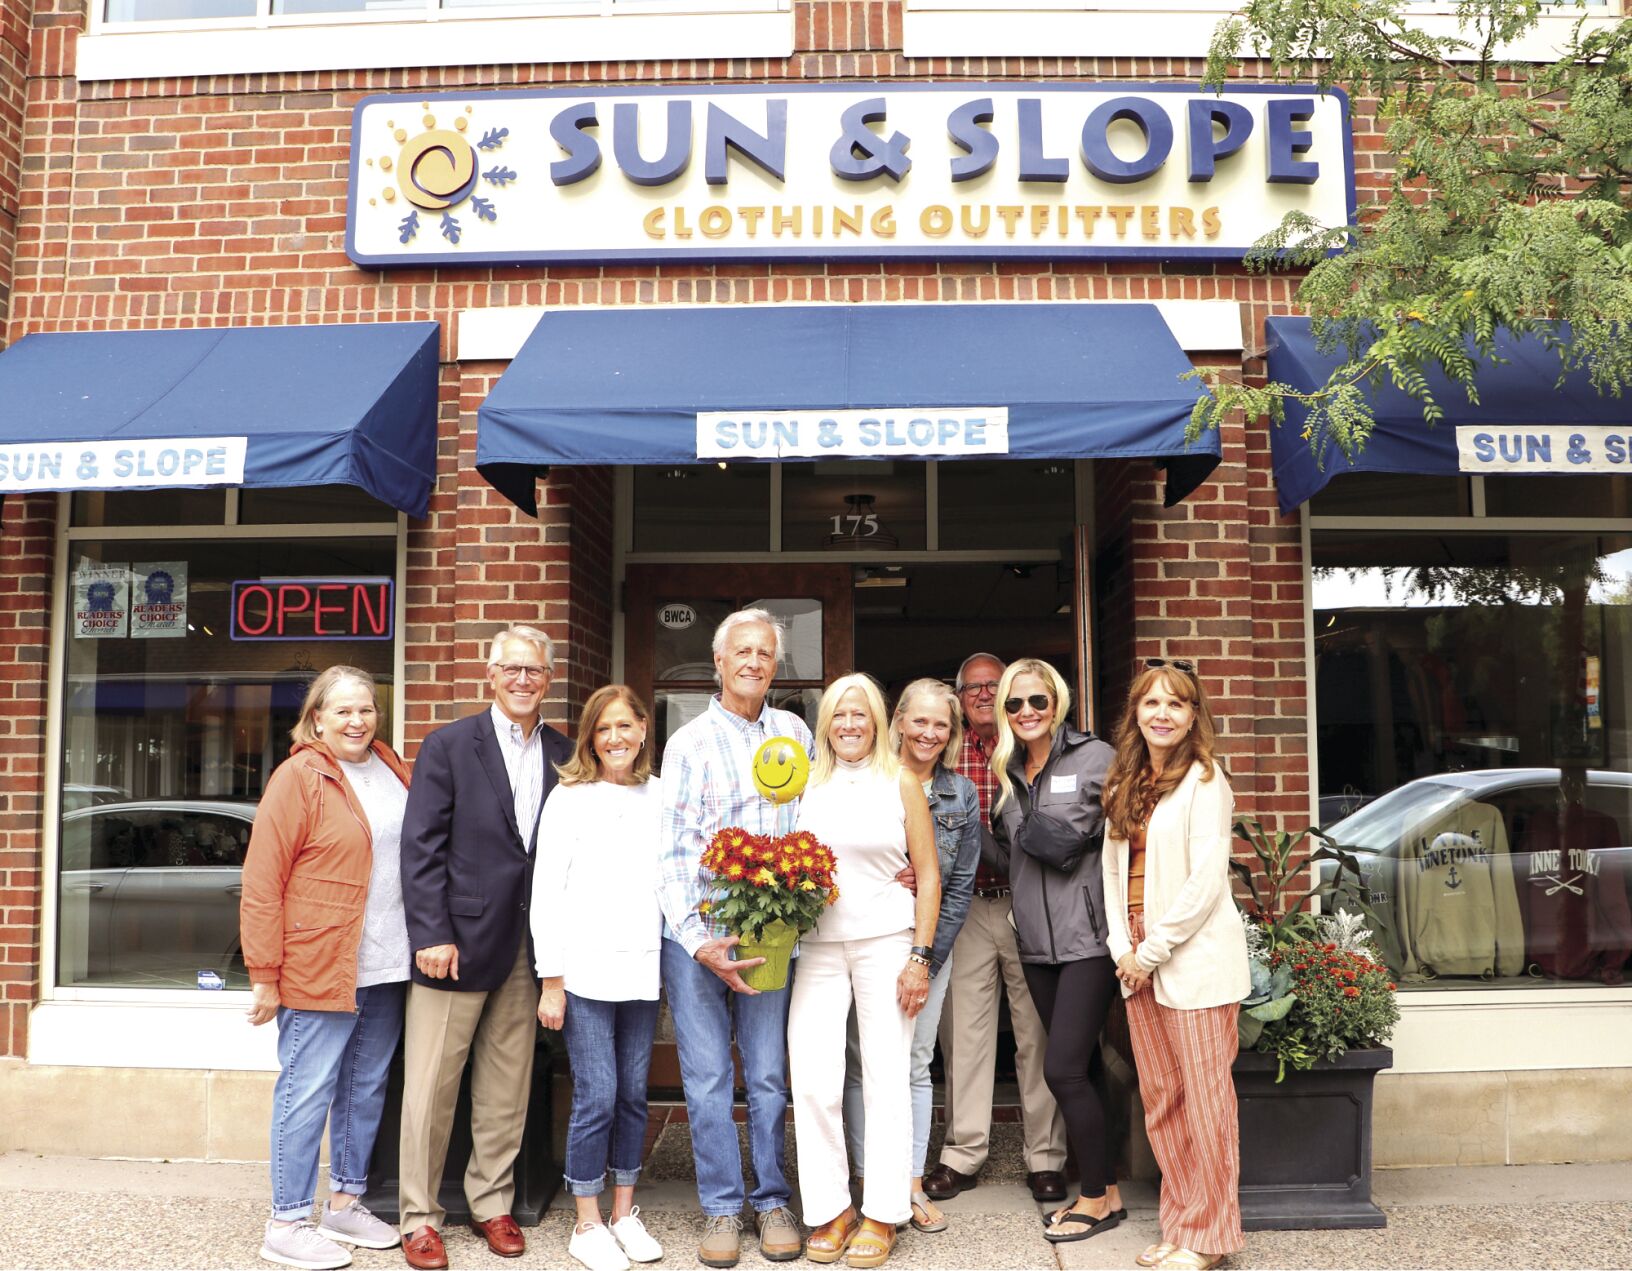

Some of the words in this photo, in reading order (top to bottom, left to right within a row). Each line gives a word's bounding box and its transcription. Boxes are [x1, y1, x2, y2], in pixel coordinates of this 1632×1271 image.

[549, 98, 788, 187] SUN
[829, 97, 912, 183] &
[946, 95, 1320, 185] SLOPE
[643, 204, 897, 239] CLOTHING
[919, 204, 1223, 238] OUTFITTERS
[715, 420, 799, 450] SUN
[816, 418, 844, 448] &
[859, 417, 988, 447] SLOPE
[1473, 433, 1552, 463] SUN
[1566, 433, 1593, 464] &
[76, 450, 99, 480] &
[114, 446, 226, 478] SLOPE
[830, 513, 879, 537] 175
[82, 620, 119, 628] CHOICE
[139, 613, 178, 622] CHOICE
[237, 583, 387, 635] OPEN
[664, 610, 692, 623] BWCA
